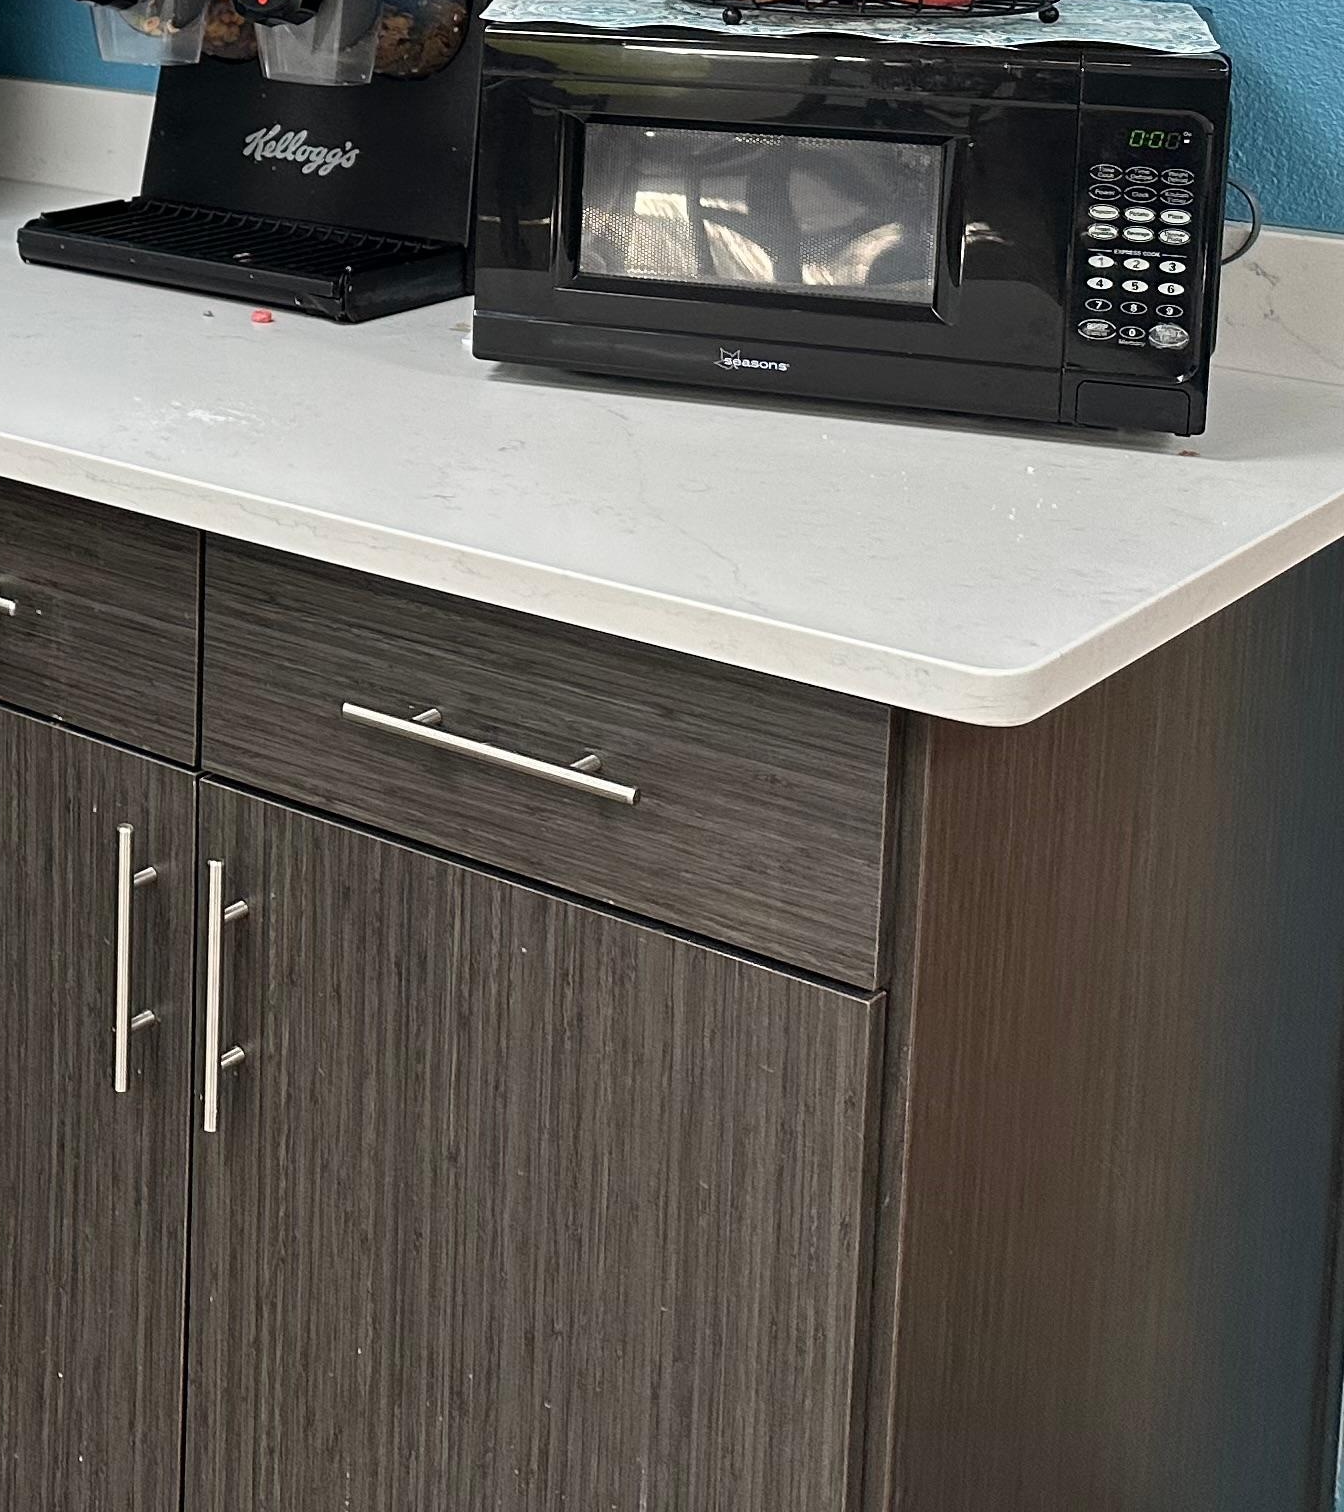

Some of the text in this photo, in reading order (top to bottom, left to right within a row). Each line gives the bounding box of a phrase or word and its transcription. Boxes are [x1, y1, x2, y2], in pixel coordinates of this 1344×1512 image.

[243, 124, 360, 176] Kellogg's
[1098, 257, 1104, 266] 1
[1132, 259, 1140, 269] 2
[1168, 262, 1177, 271] 3
[1096, 279, 1103, 287] 4
[1132, 282, 1139, 290] 5
[1167, 285, 1175, 294] 6
[1095, 300, 1103, 309] 7
[1130, 304, 1137, 313] 8
[1165, 306, 1174, 316] 9
[1128, 328, 1136, 337] 0
[723, 357, 788, 372] seasons
